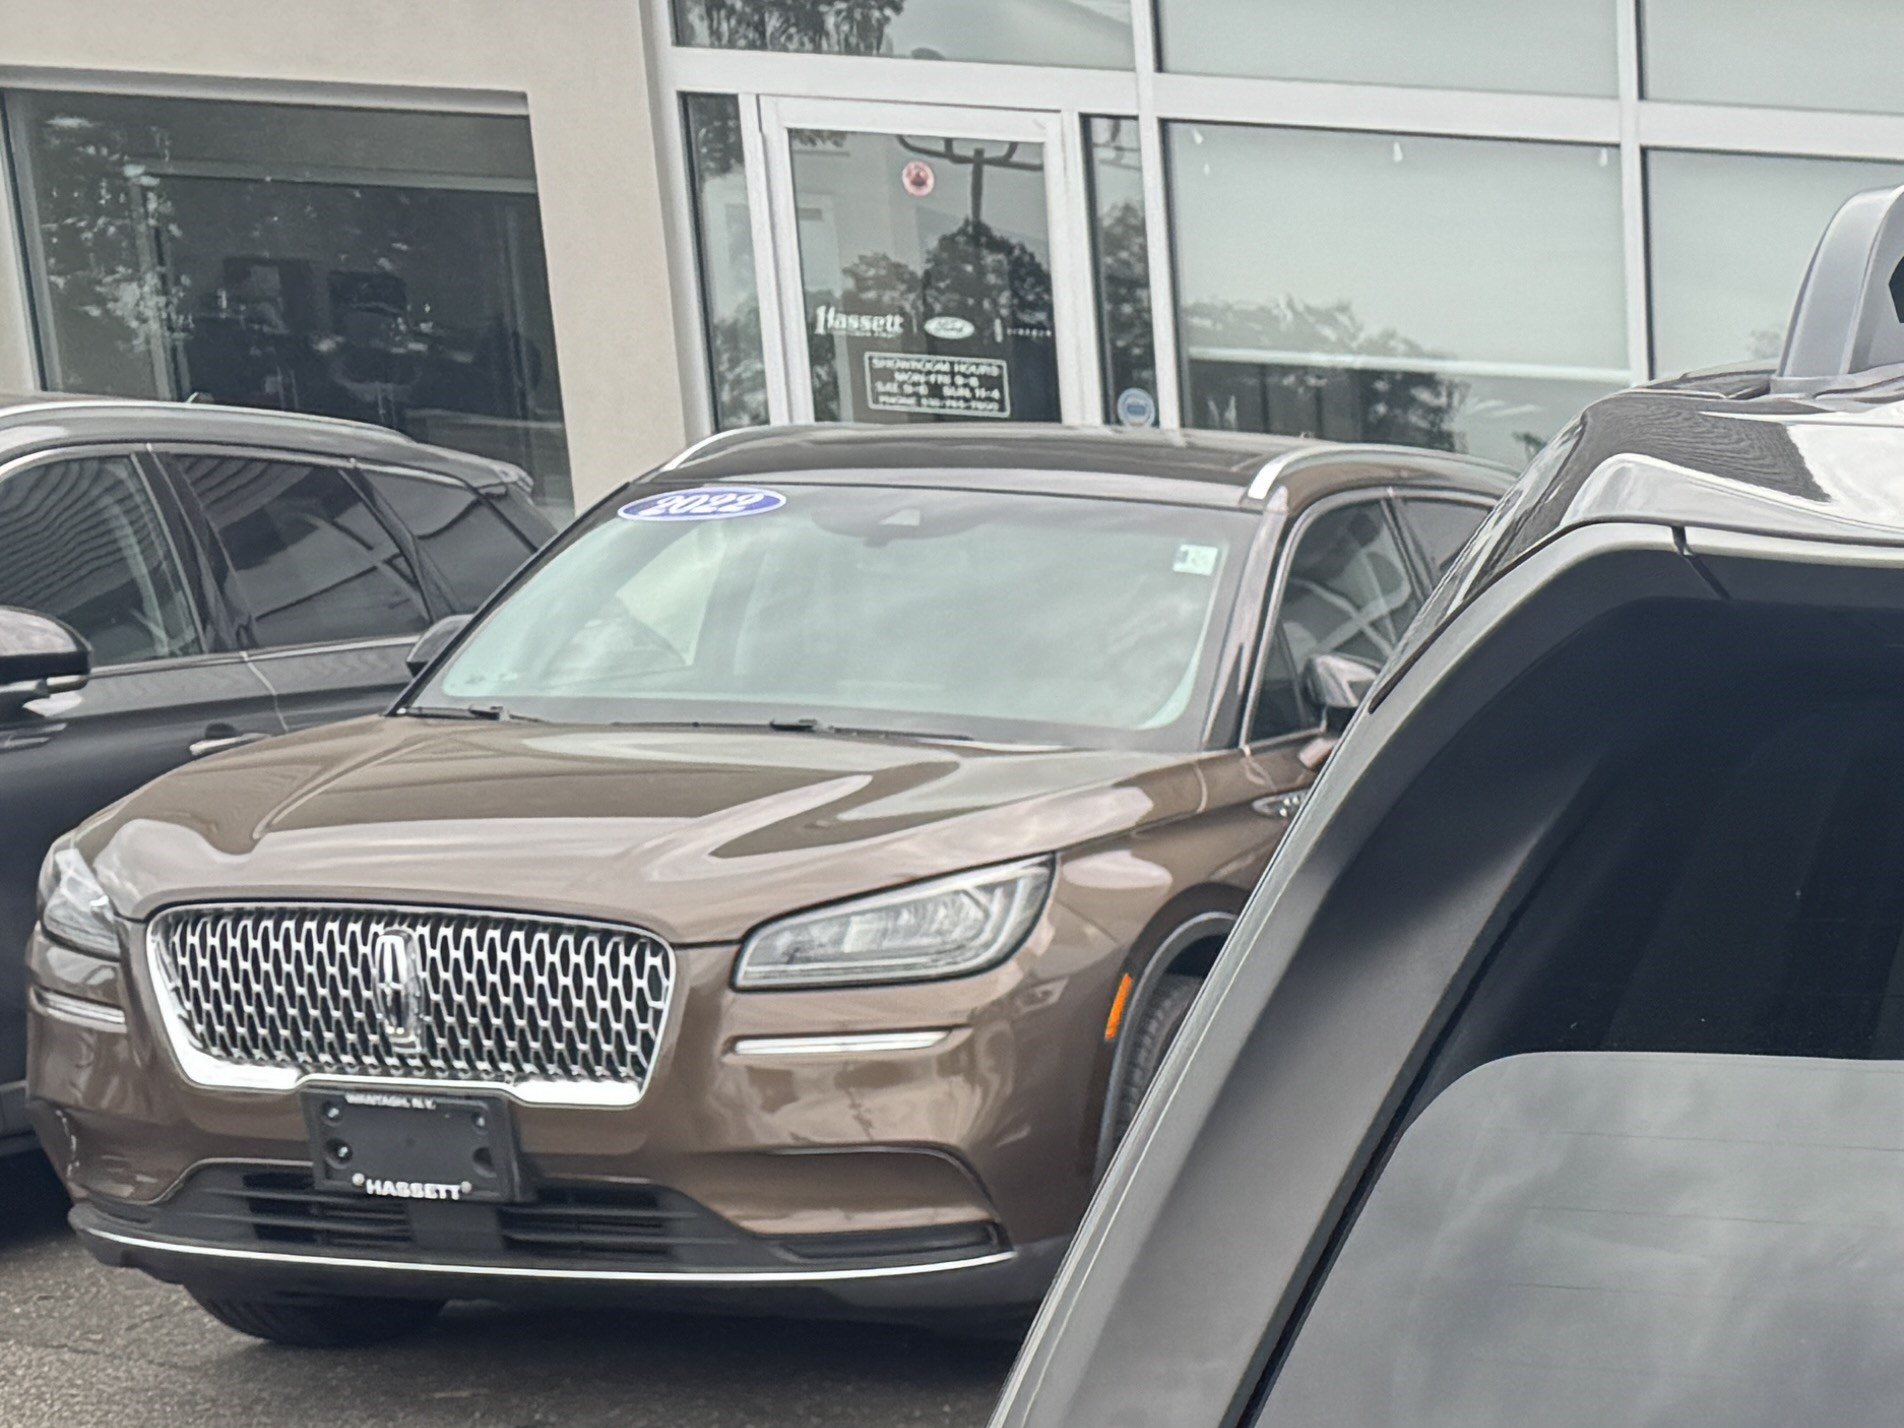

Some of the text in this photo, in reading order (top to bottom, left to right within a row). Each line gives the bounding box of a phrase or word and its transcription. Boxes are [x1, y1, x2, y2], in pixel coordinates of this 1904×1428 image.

[815, 305, 904, 336] Hassett
[638, 493, 765, 516] 2022
[366, 1179, 460, 1200] HASSETT
